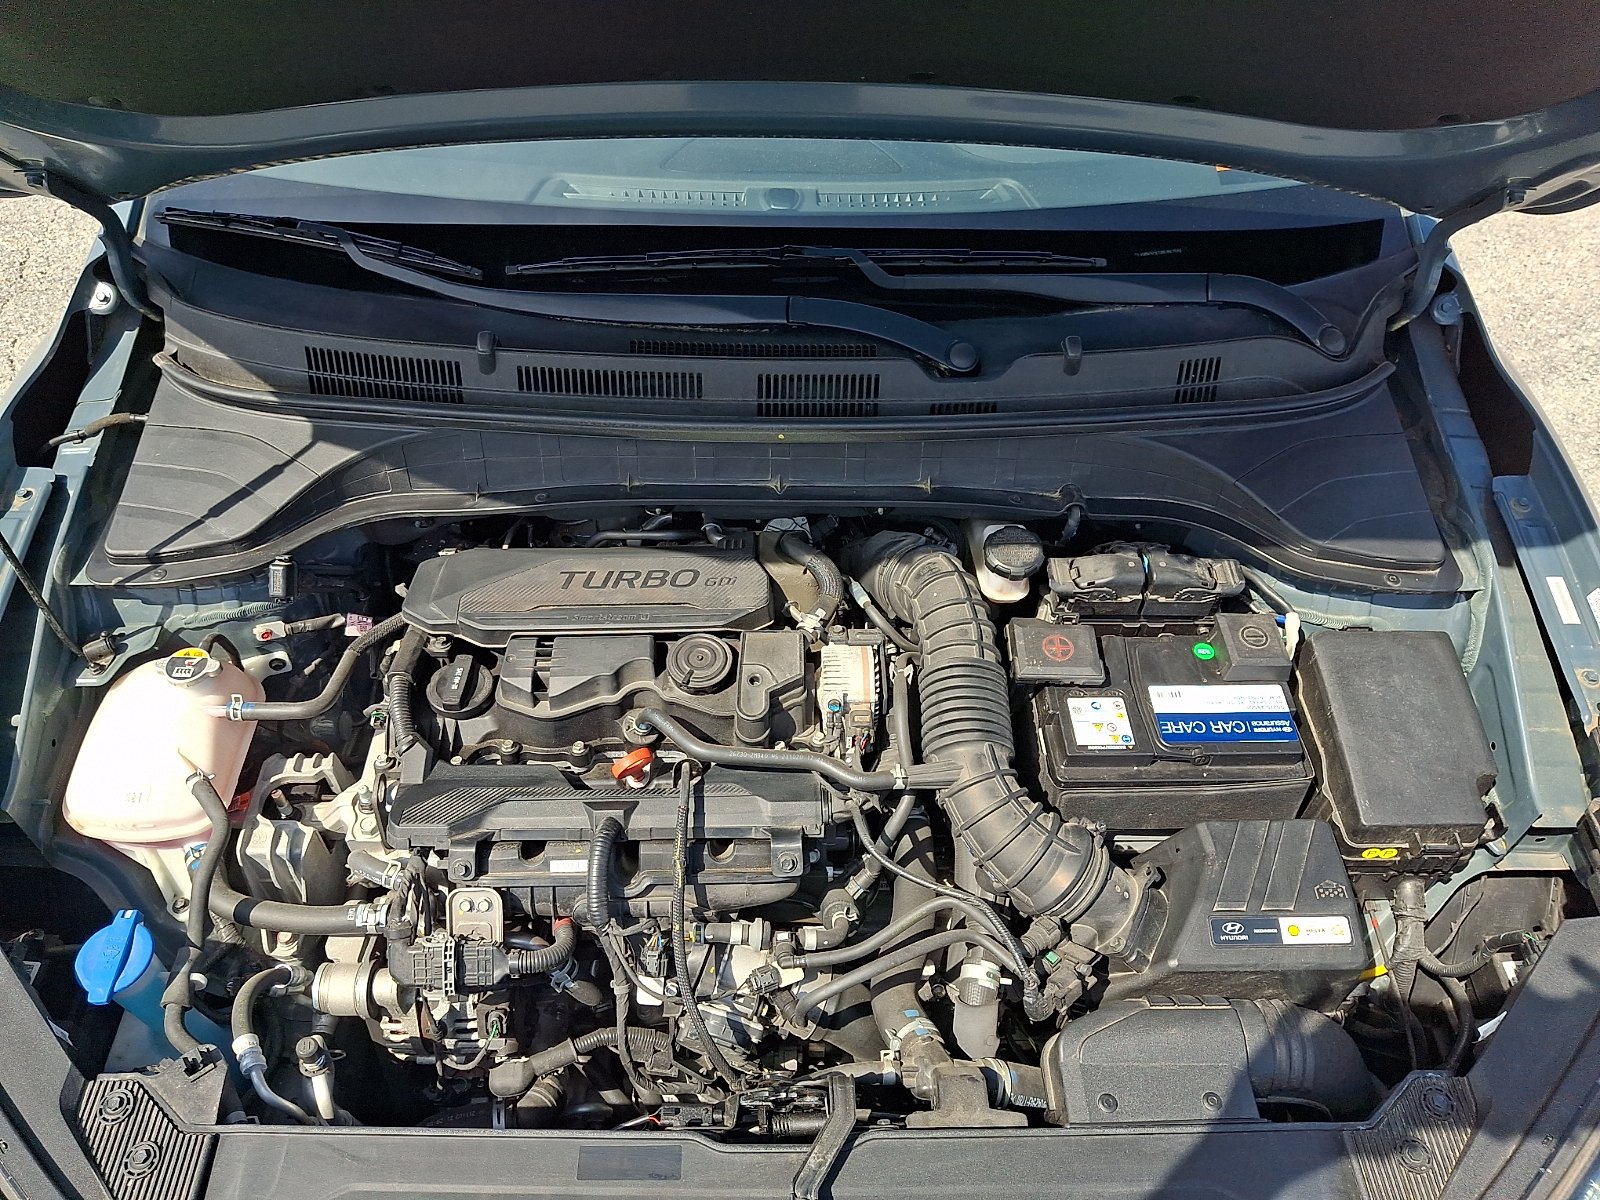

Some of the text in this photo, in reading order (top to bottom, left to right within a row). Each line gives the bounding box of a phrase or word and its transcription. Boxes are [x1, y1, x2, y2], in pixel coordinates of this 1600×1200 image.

[559, 569, 701, 590] TURBO
[1159, 720, 1247, 735] CAR CARE
